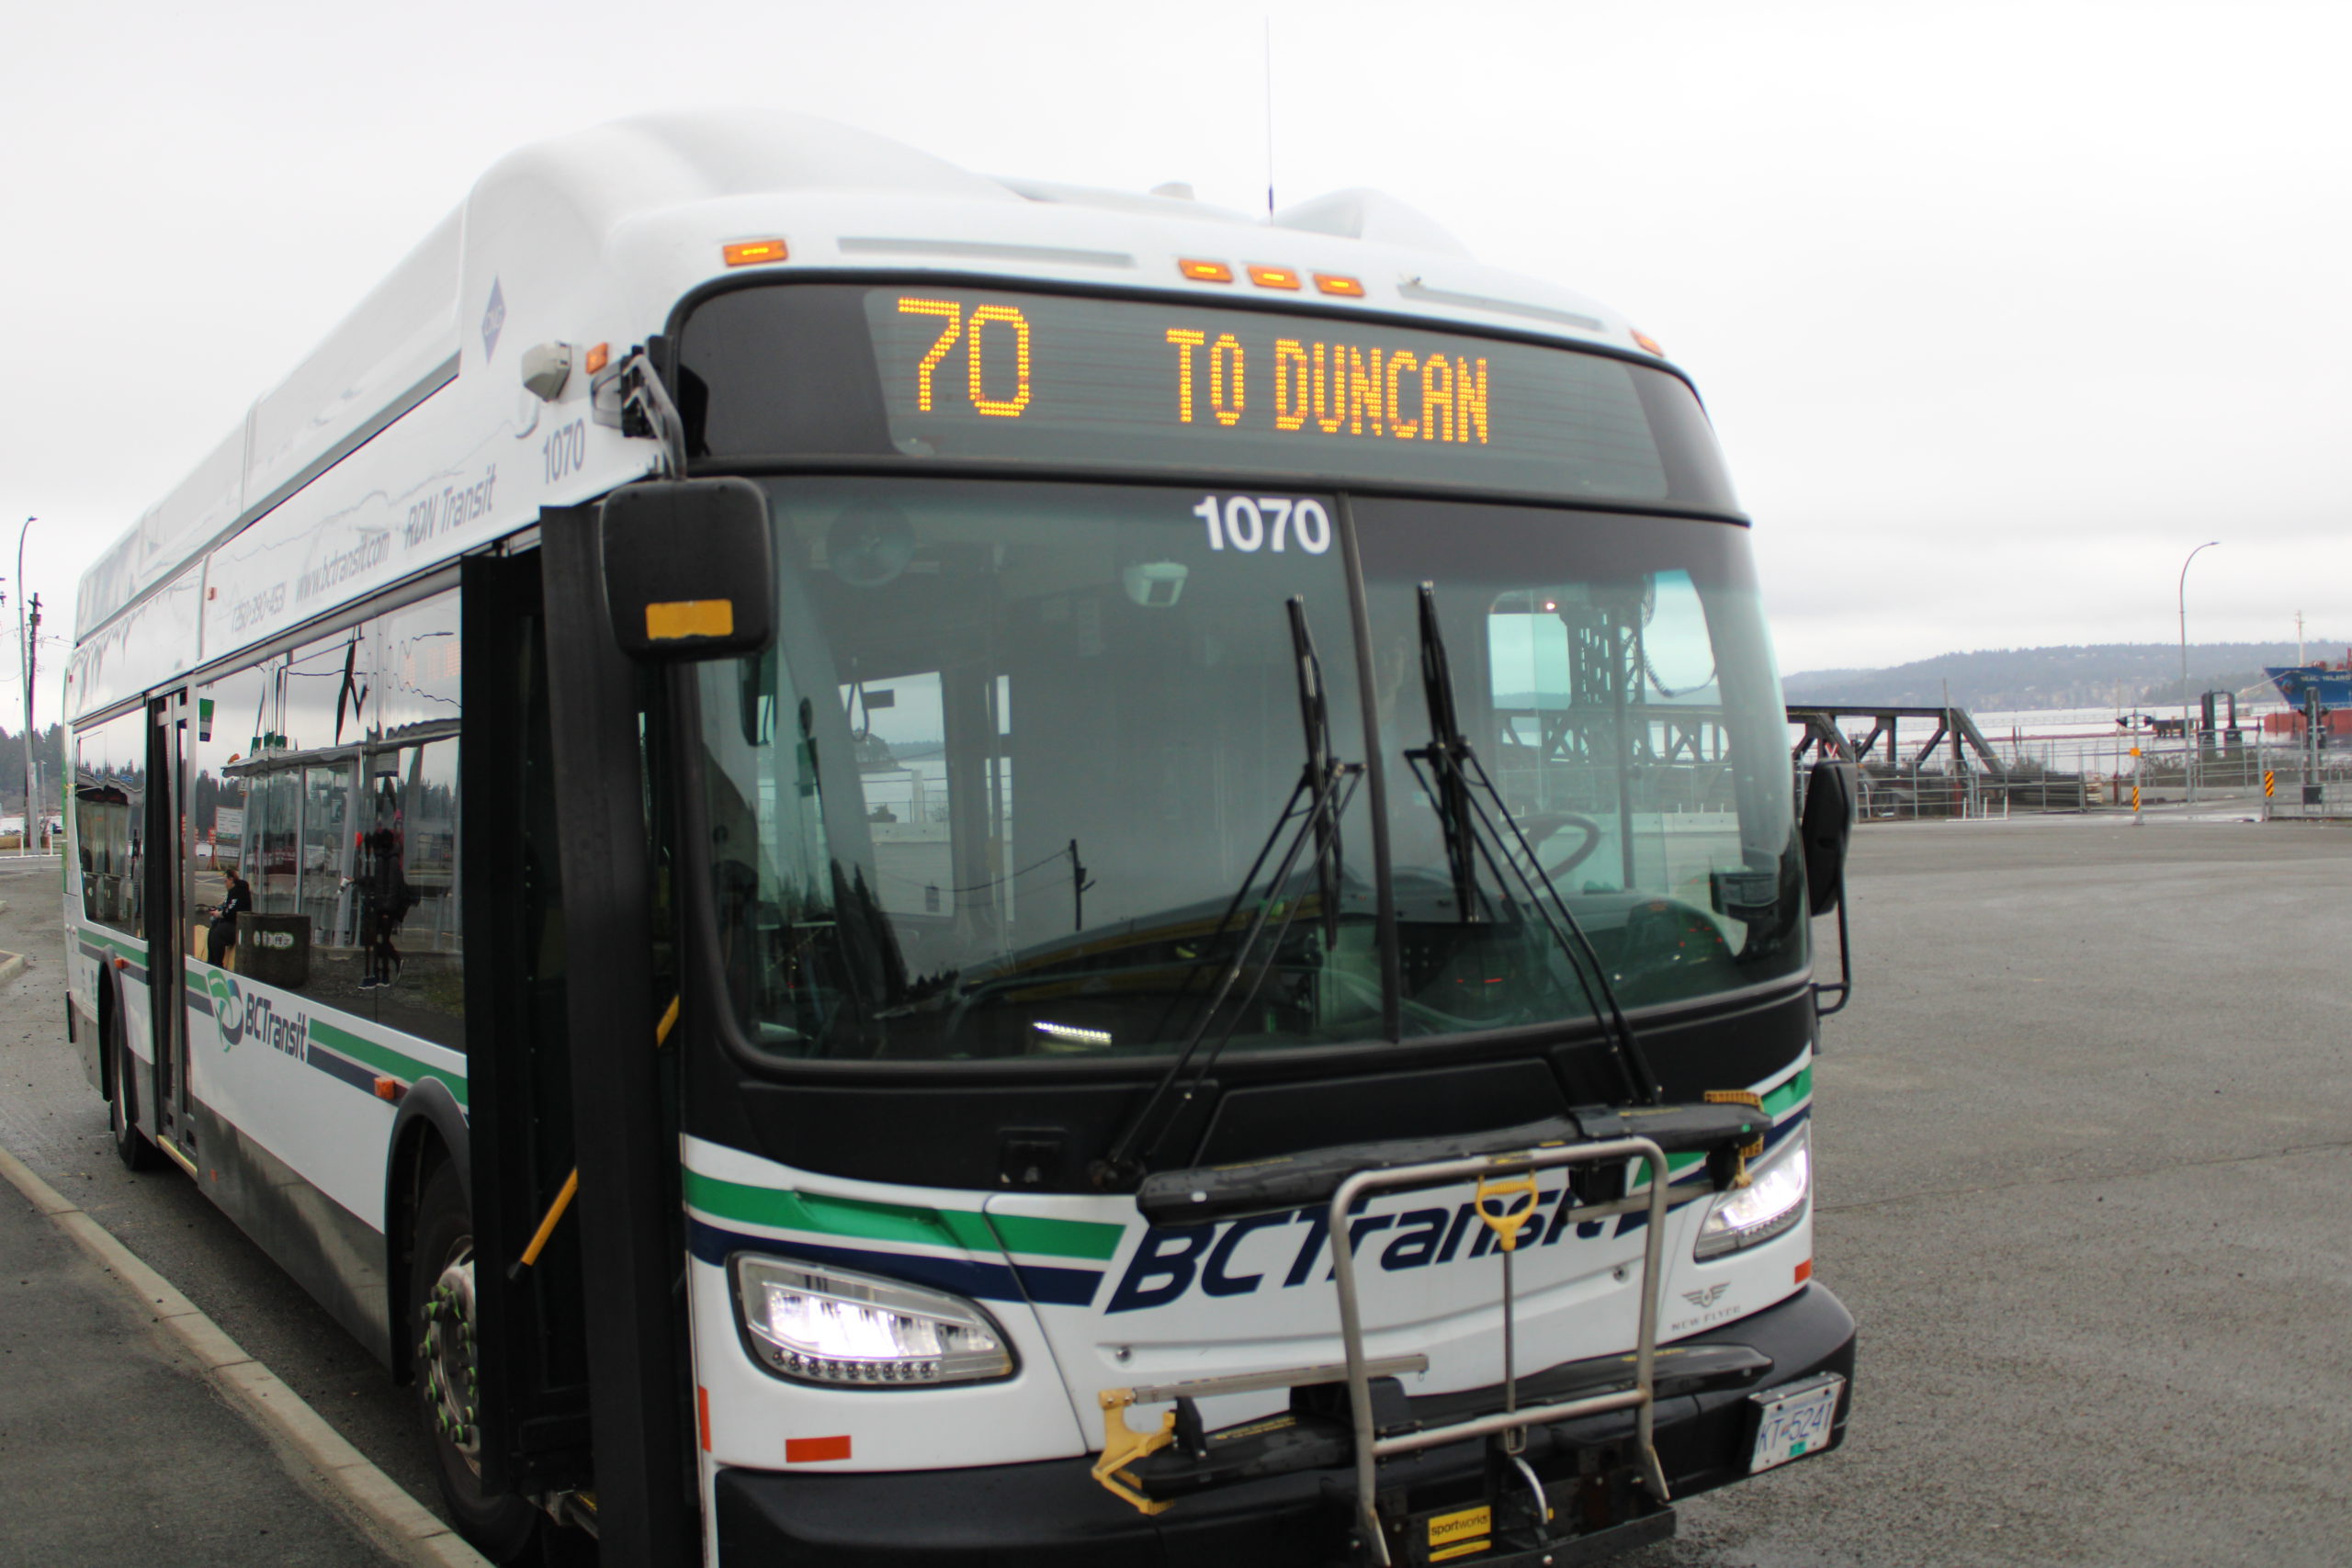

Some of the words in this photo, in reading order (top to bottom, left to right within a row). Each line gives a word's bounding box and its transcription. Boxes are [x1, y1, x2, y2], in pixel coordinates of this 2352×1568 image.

[898, 297, 1031, 416] 70
[1166, 328, 1245, 425] TO
[1275, 338, 1488, 445] DUNCAN
[543, 418, 585, 485] 1070
[404, 492, 438, 549] RDN
[440, 462, 497, 534] Transit
[1194, 495, 1332, 554] 1070
[244, 992, 308, 1062] BCTransit
[1430, 1514, 1488, 1537] sportworks
